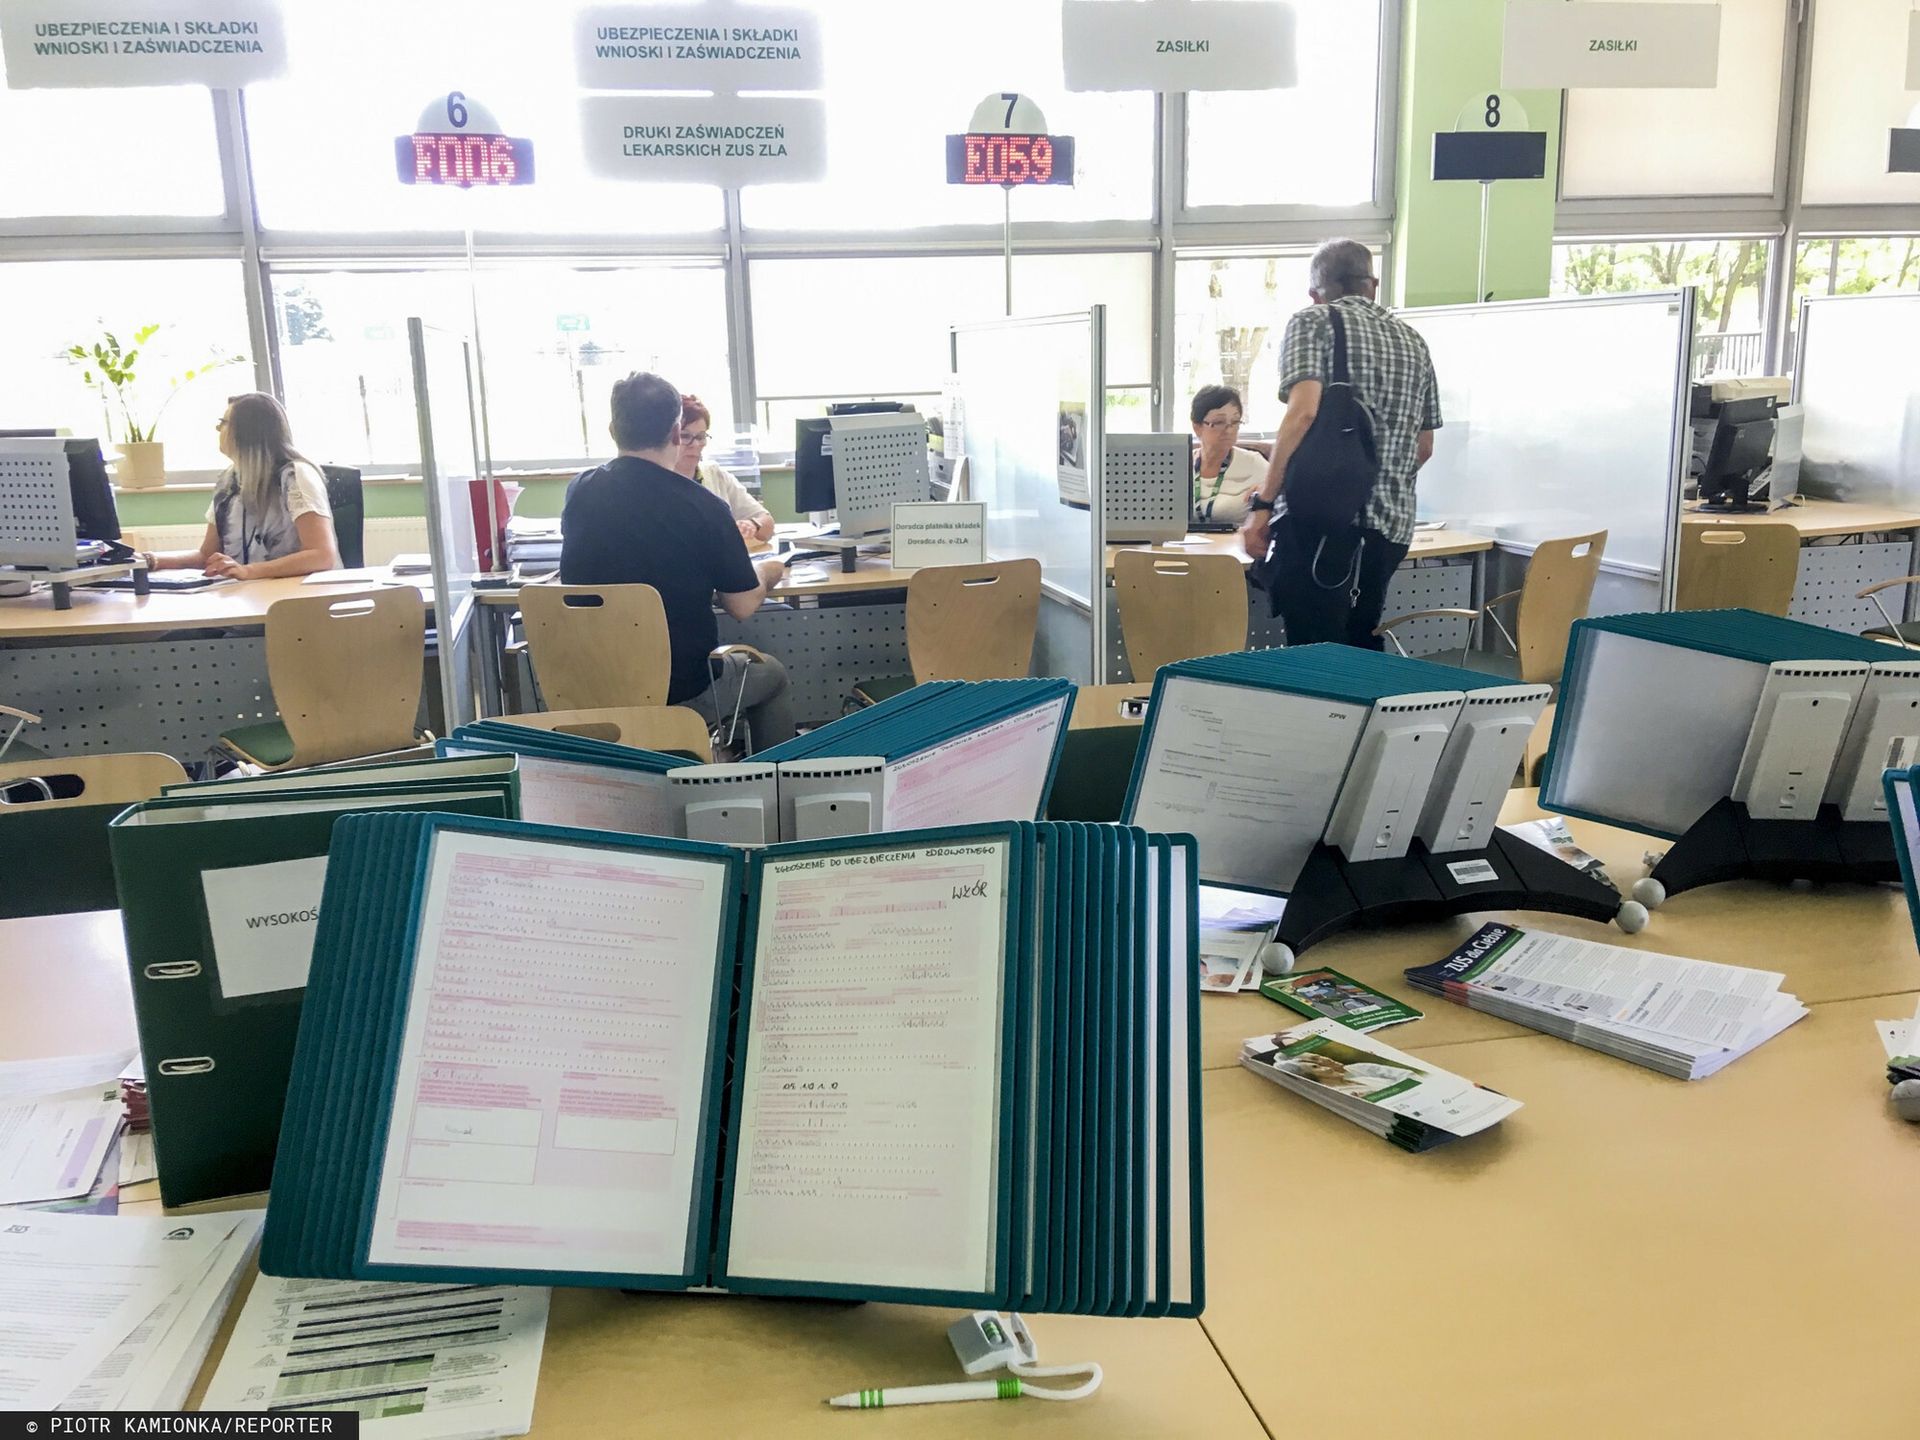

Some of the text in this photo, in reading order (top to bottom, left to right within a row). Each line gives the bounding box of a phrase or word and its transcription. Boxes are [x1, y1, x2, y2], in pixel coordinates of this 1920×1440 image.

[35, 21, 259, 37] UBEZPIECZENIA I SKŁADKI
[597, 27, 798, 41] UBEZPIECZENIA I SKŁADKI
[34, 38, 263, 55] WNIOSKI I ZAŚWIADCZENIA
[595, 43, 801, 59] WNIOSKI I ZAŚWIADCZENIA
[1156, 40, 1210, 52] ZASIŁKI
[1589, 40, 1638, 51] ZASIŁKI
[447, 91, 468, 128] 6
[1001, 93, 1019, 128] 7
[1485, 94, 1501, 128] 8
[623, 123, 785, 139] DRUKI ZAŚWIADCZEŃ
[623, 144, 788, 156] LEKARSKICH ZUS ZLA
[965, 136, 1052, 182] E059
[830, 858, 841, 867] DO
[1444, 955, 1473, 972] ZUS
[1472, 928, 1507, 950] Ciebie
